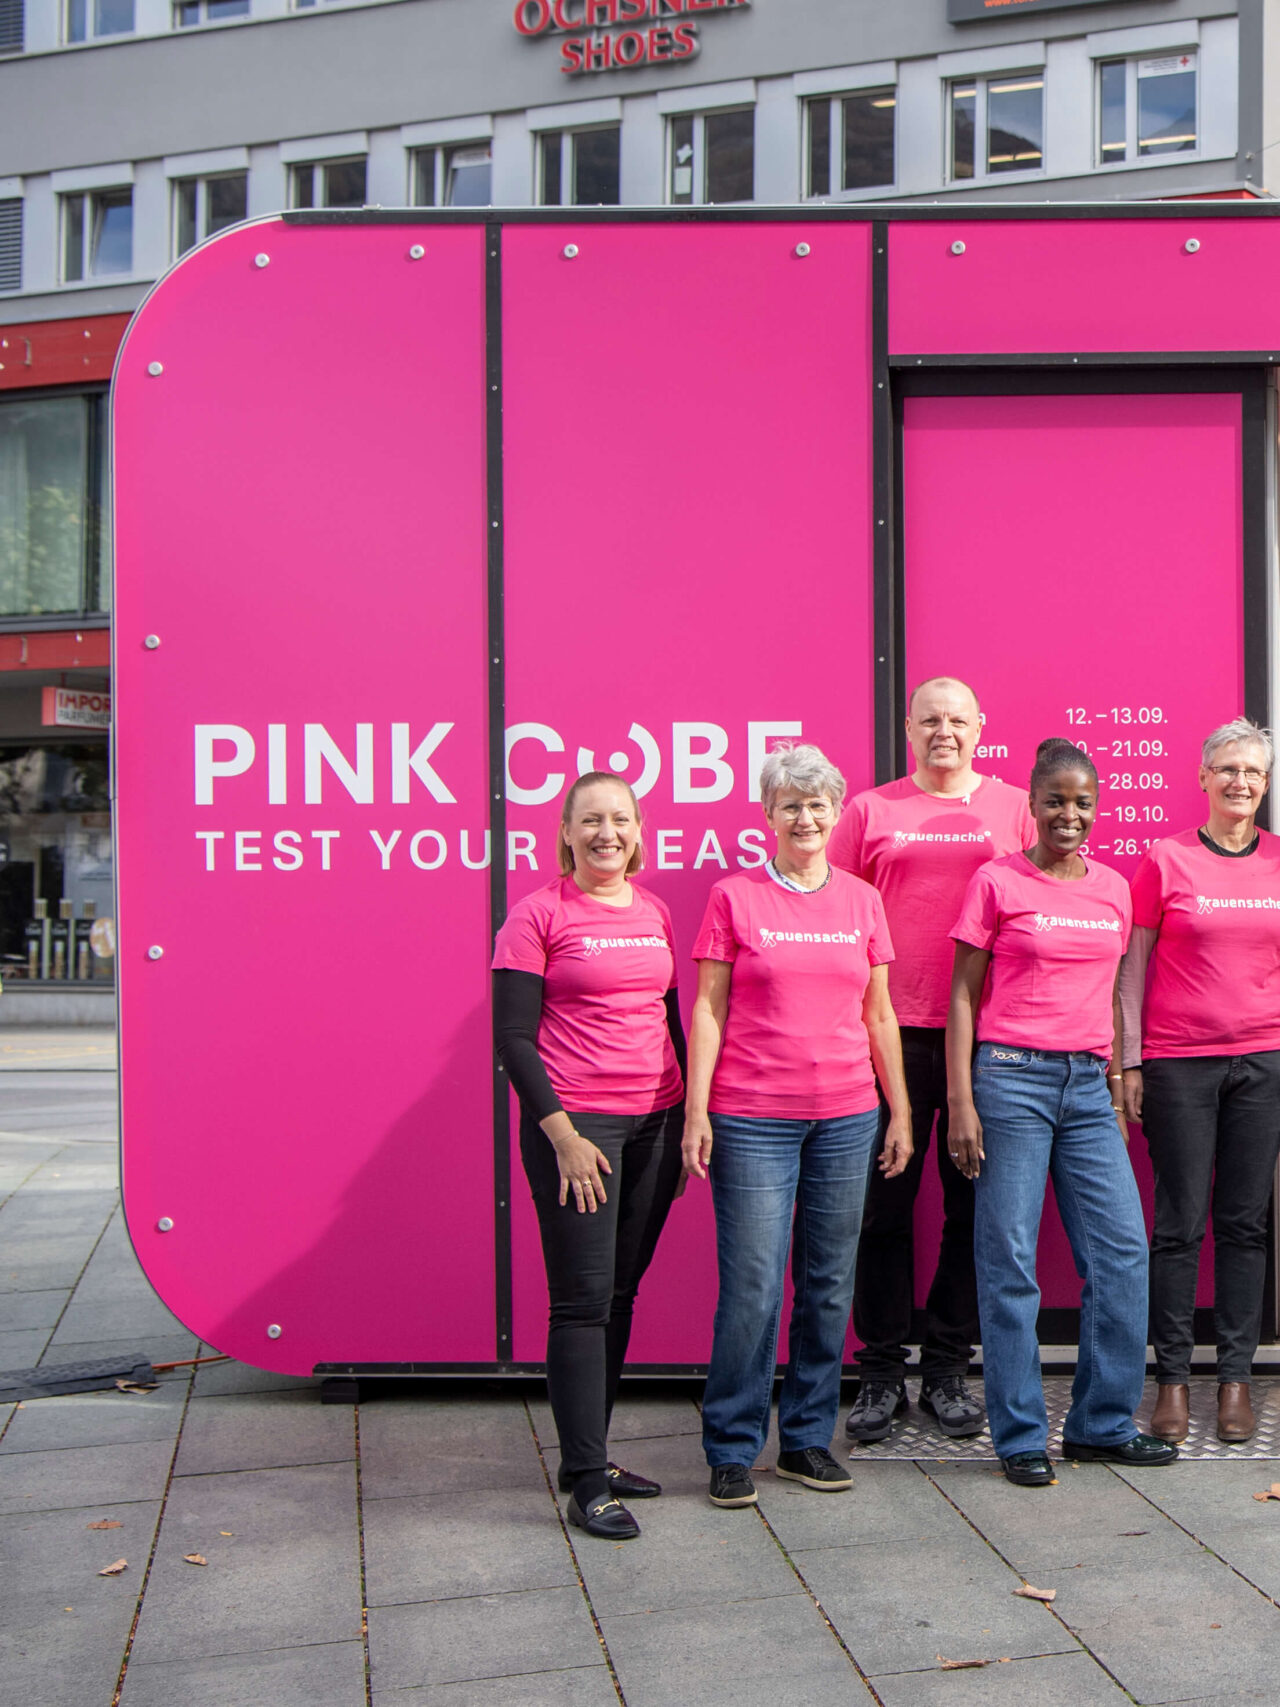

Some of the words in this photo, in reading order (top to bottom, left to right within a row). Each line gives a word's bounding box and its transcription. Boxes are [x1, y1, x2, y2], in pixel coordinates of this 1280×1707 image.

[560, 23, 697, 73] SHOES
[194, 721, 458, 806] PINK
[195, 829, 341, 872] TEST
[369, 829, 539, 871] YOUR
[641, 828, 777, 870] EAS
